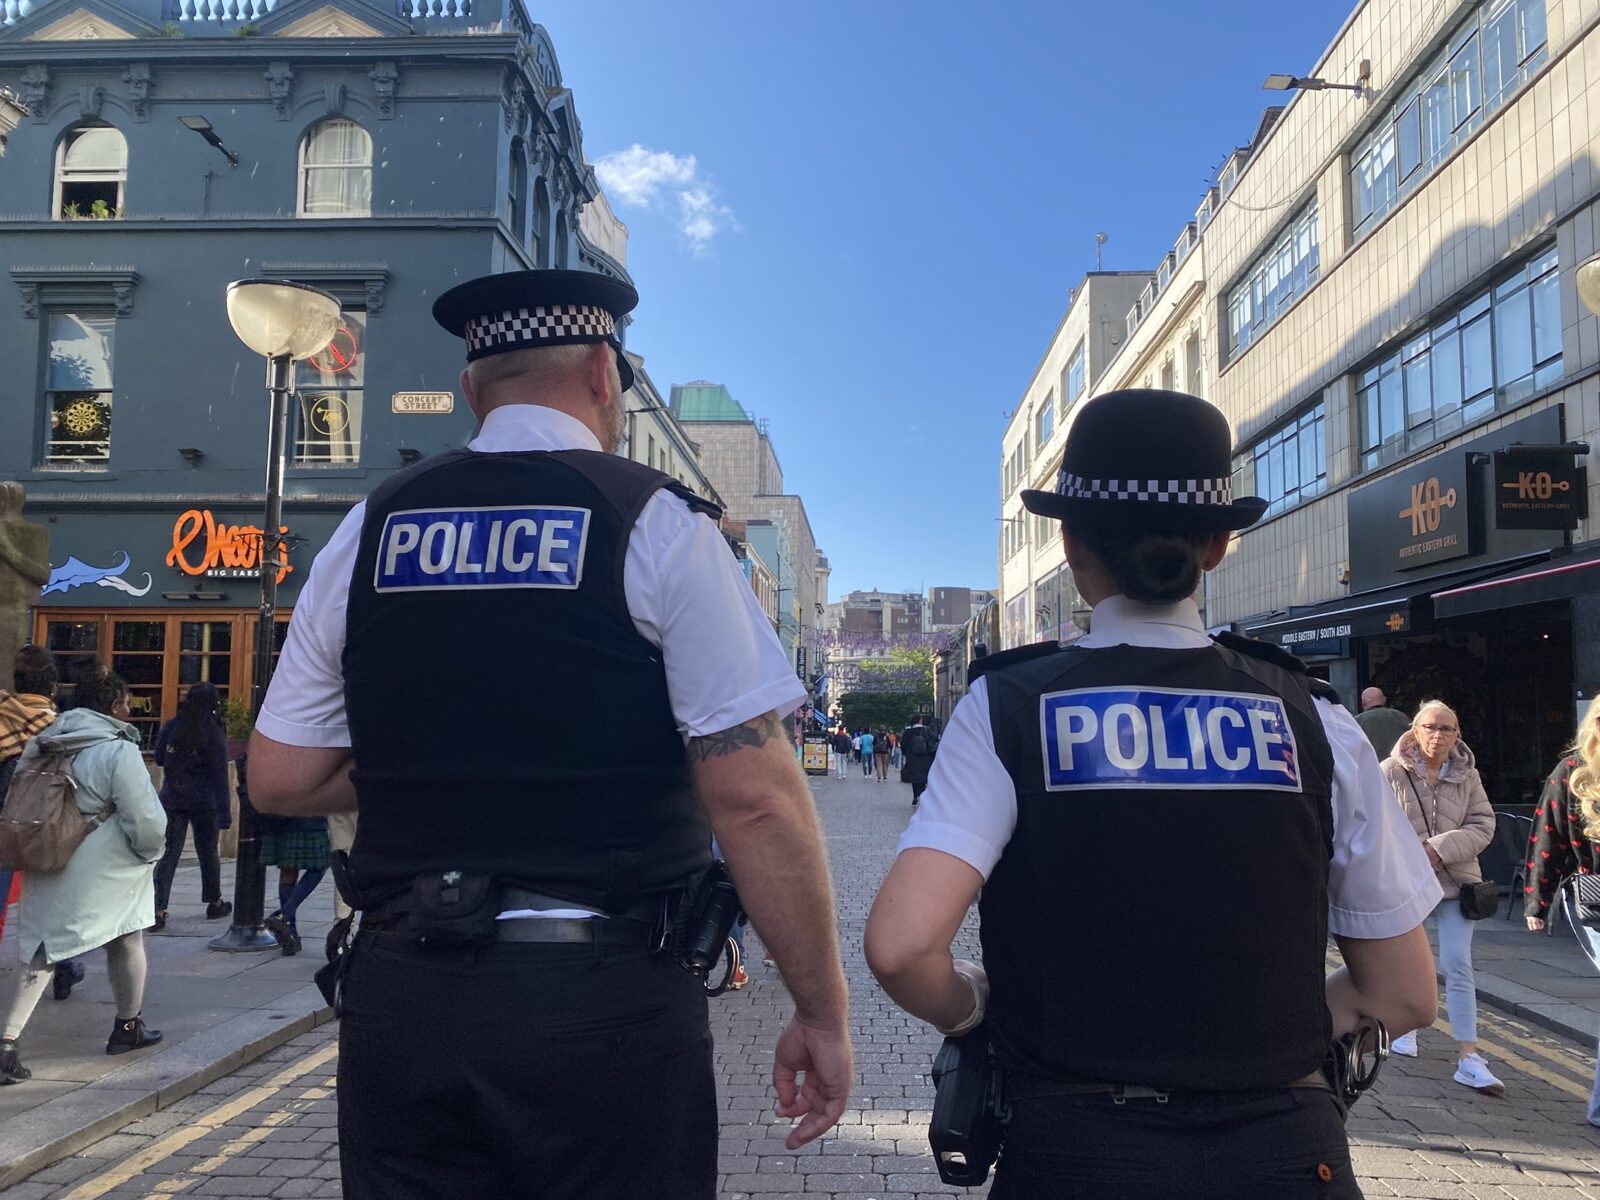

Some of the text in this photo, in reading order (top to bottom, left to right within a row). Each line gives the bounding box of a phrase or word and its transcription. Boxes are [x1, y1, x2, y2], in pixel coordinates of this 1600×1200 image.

[1519, 471, 1552, 499] KO
[1411, 477, 1440, 536] KO
[384, 518, 574, 576] POLICE
[1399, 533, 1457, 558] AUTHENTIC EASTERN GRILL
[207, 569, 260, 577] BIG EARS
[1281, 632, 1298, 644] MIDDLE
[1298, 629, 1316, 642] EASTERN
[1320, 626, 1336, 639] SOUTH
[1336, 624, 1352, 637] ASIAN
[1055, 703, 1289, 772] POLICE
